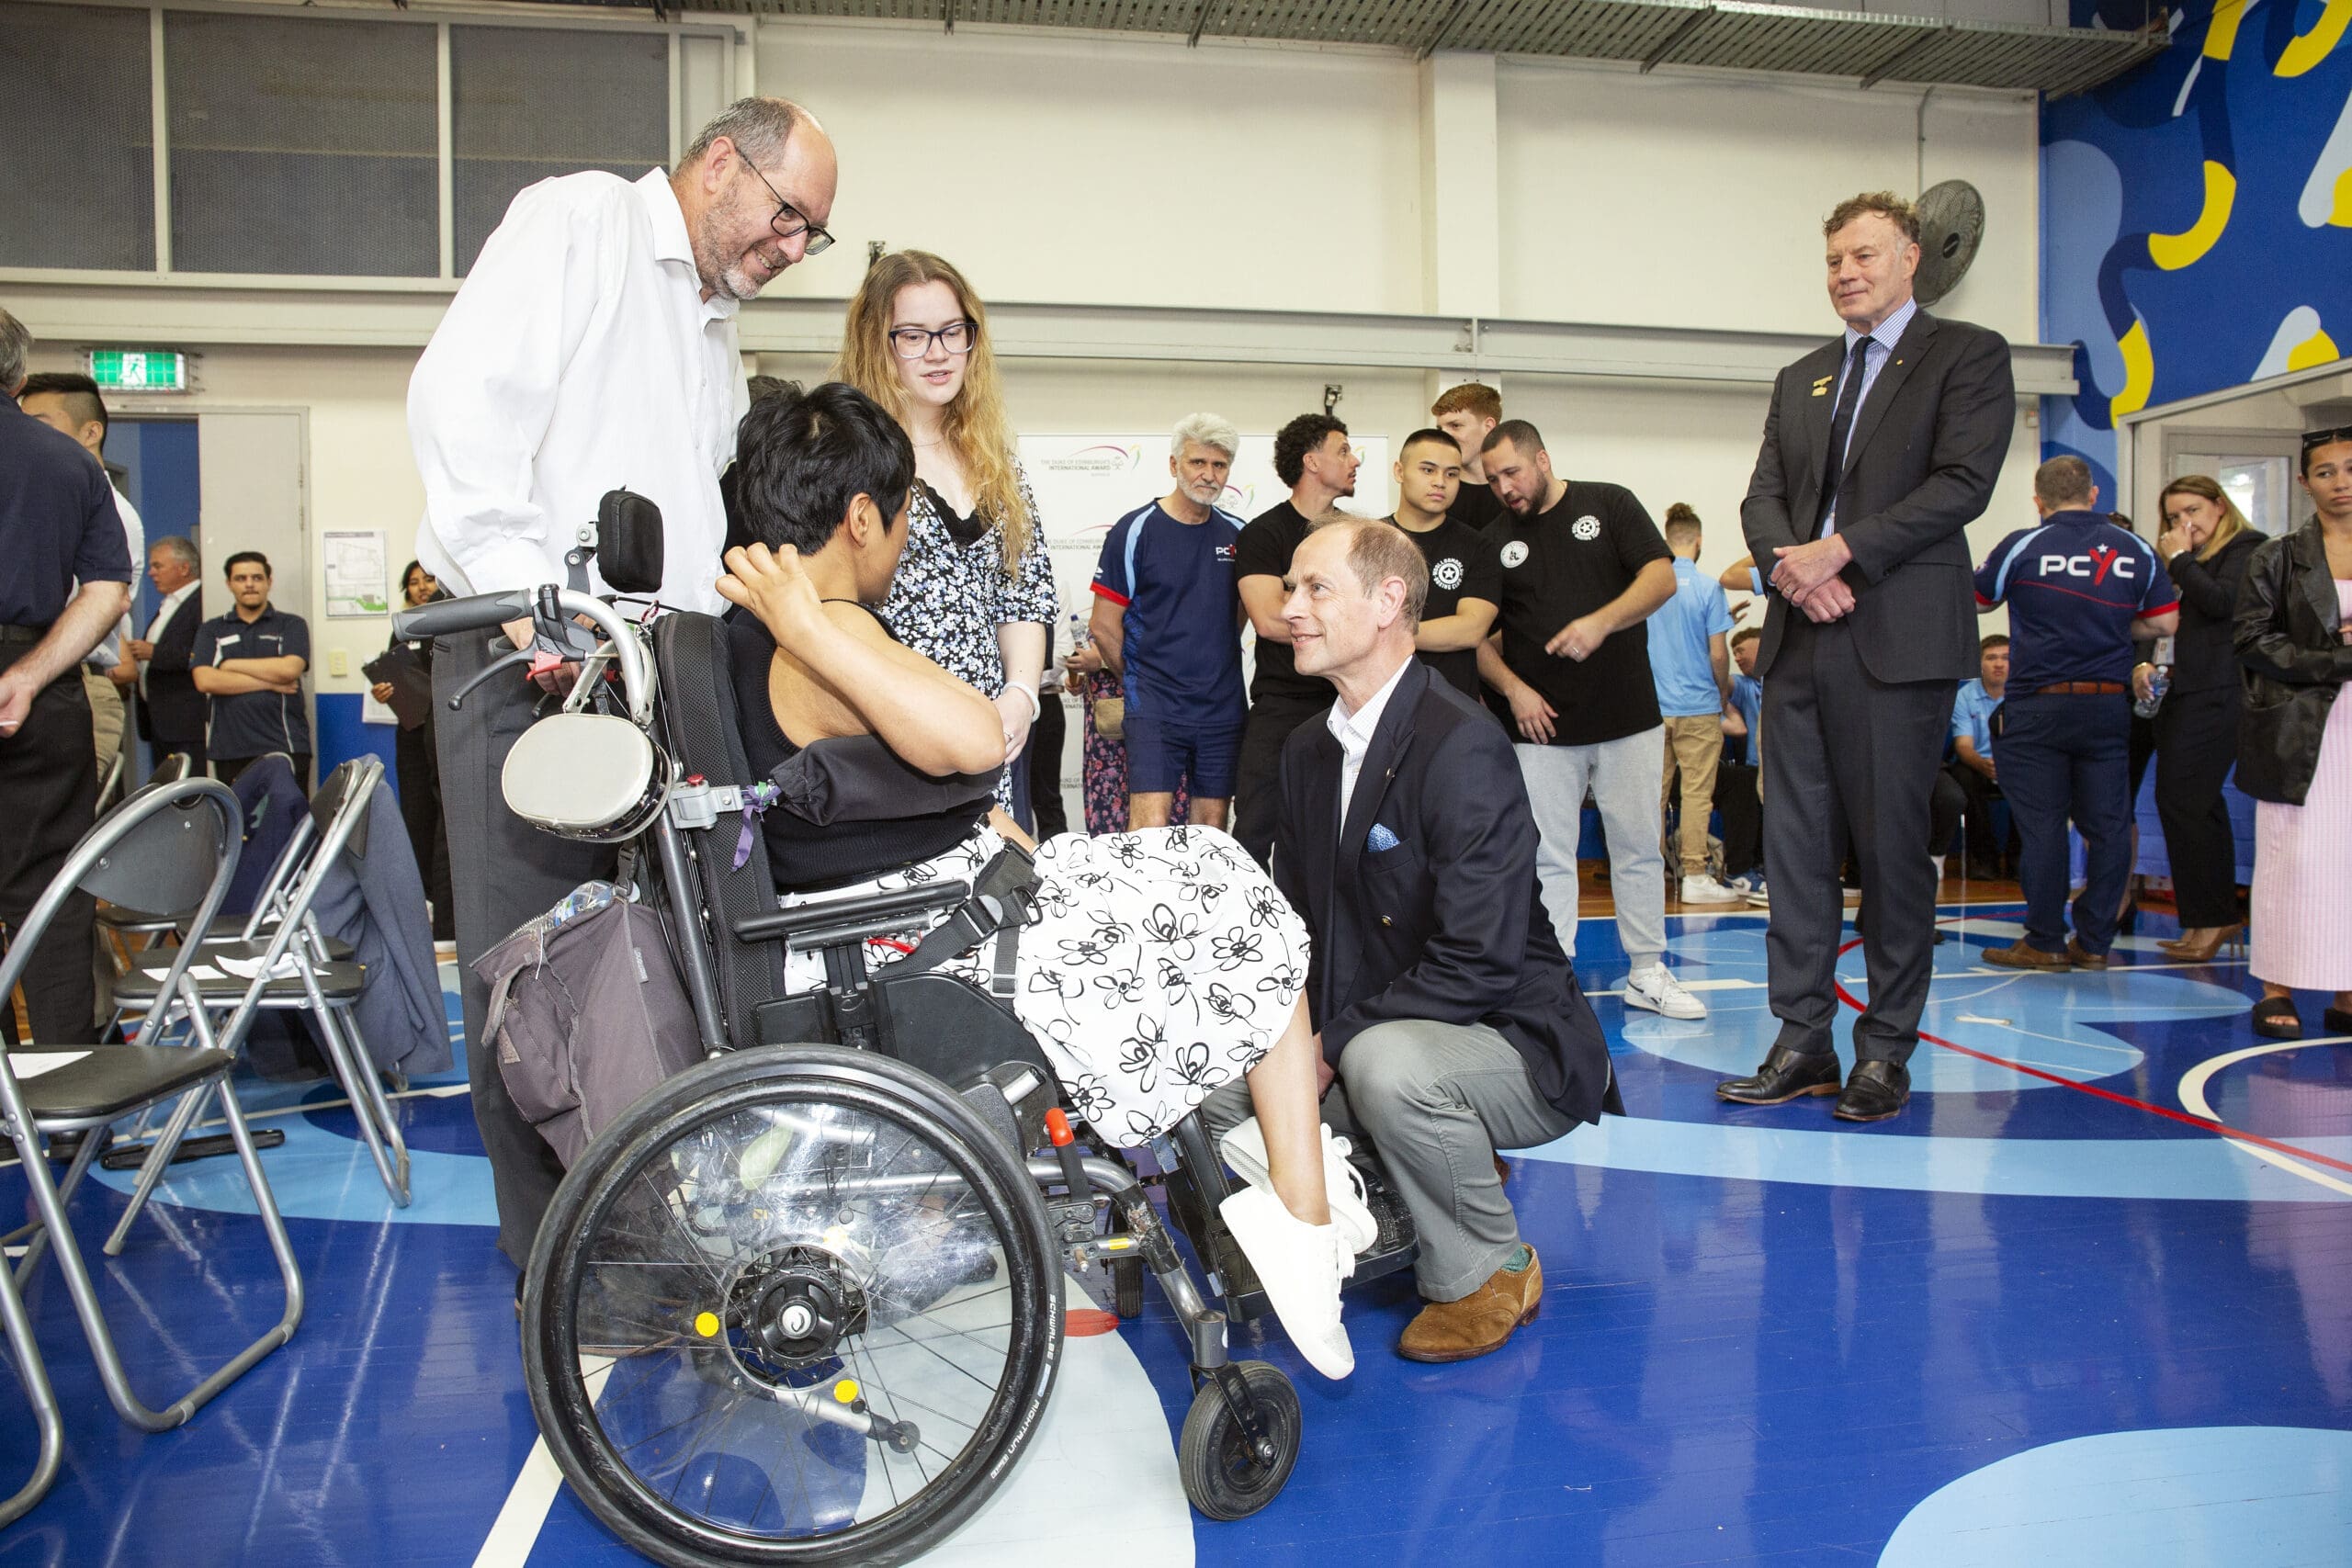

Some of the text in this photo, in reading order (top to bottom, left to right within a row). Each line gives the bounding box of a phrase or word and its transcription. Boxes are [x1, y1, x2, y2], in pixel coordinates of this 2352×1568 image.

[1216, 545, 1237, 558] PCY
[2039, 549, 2135, 586] PCYC
[1008, 1293, 1057, 1454] SCHWALBE RIGHTRUN
